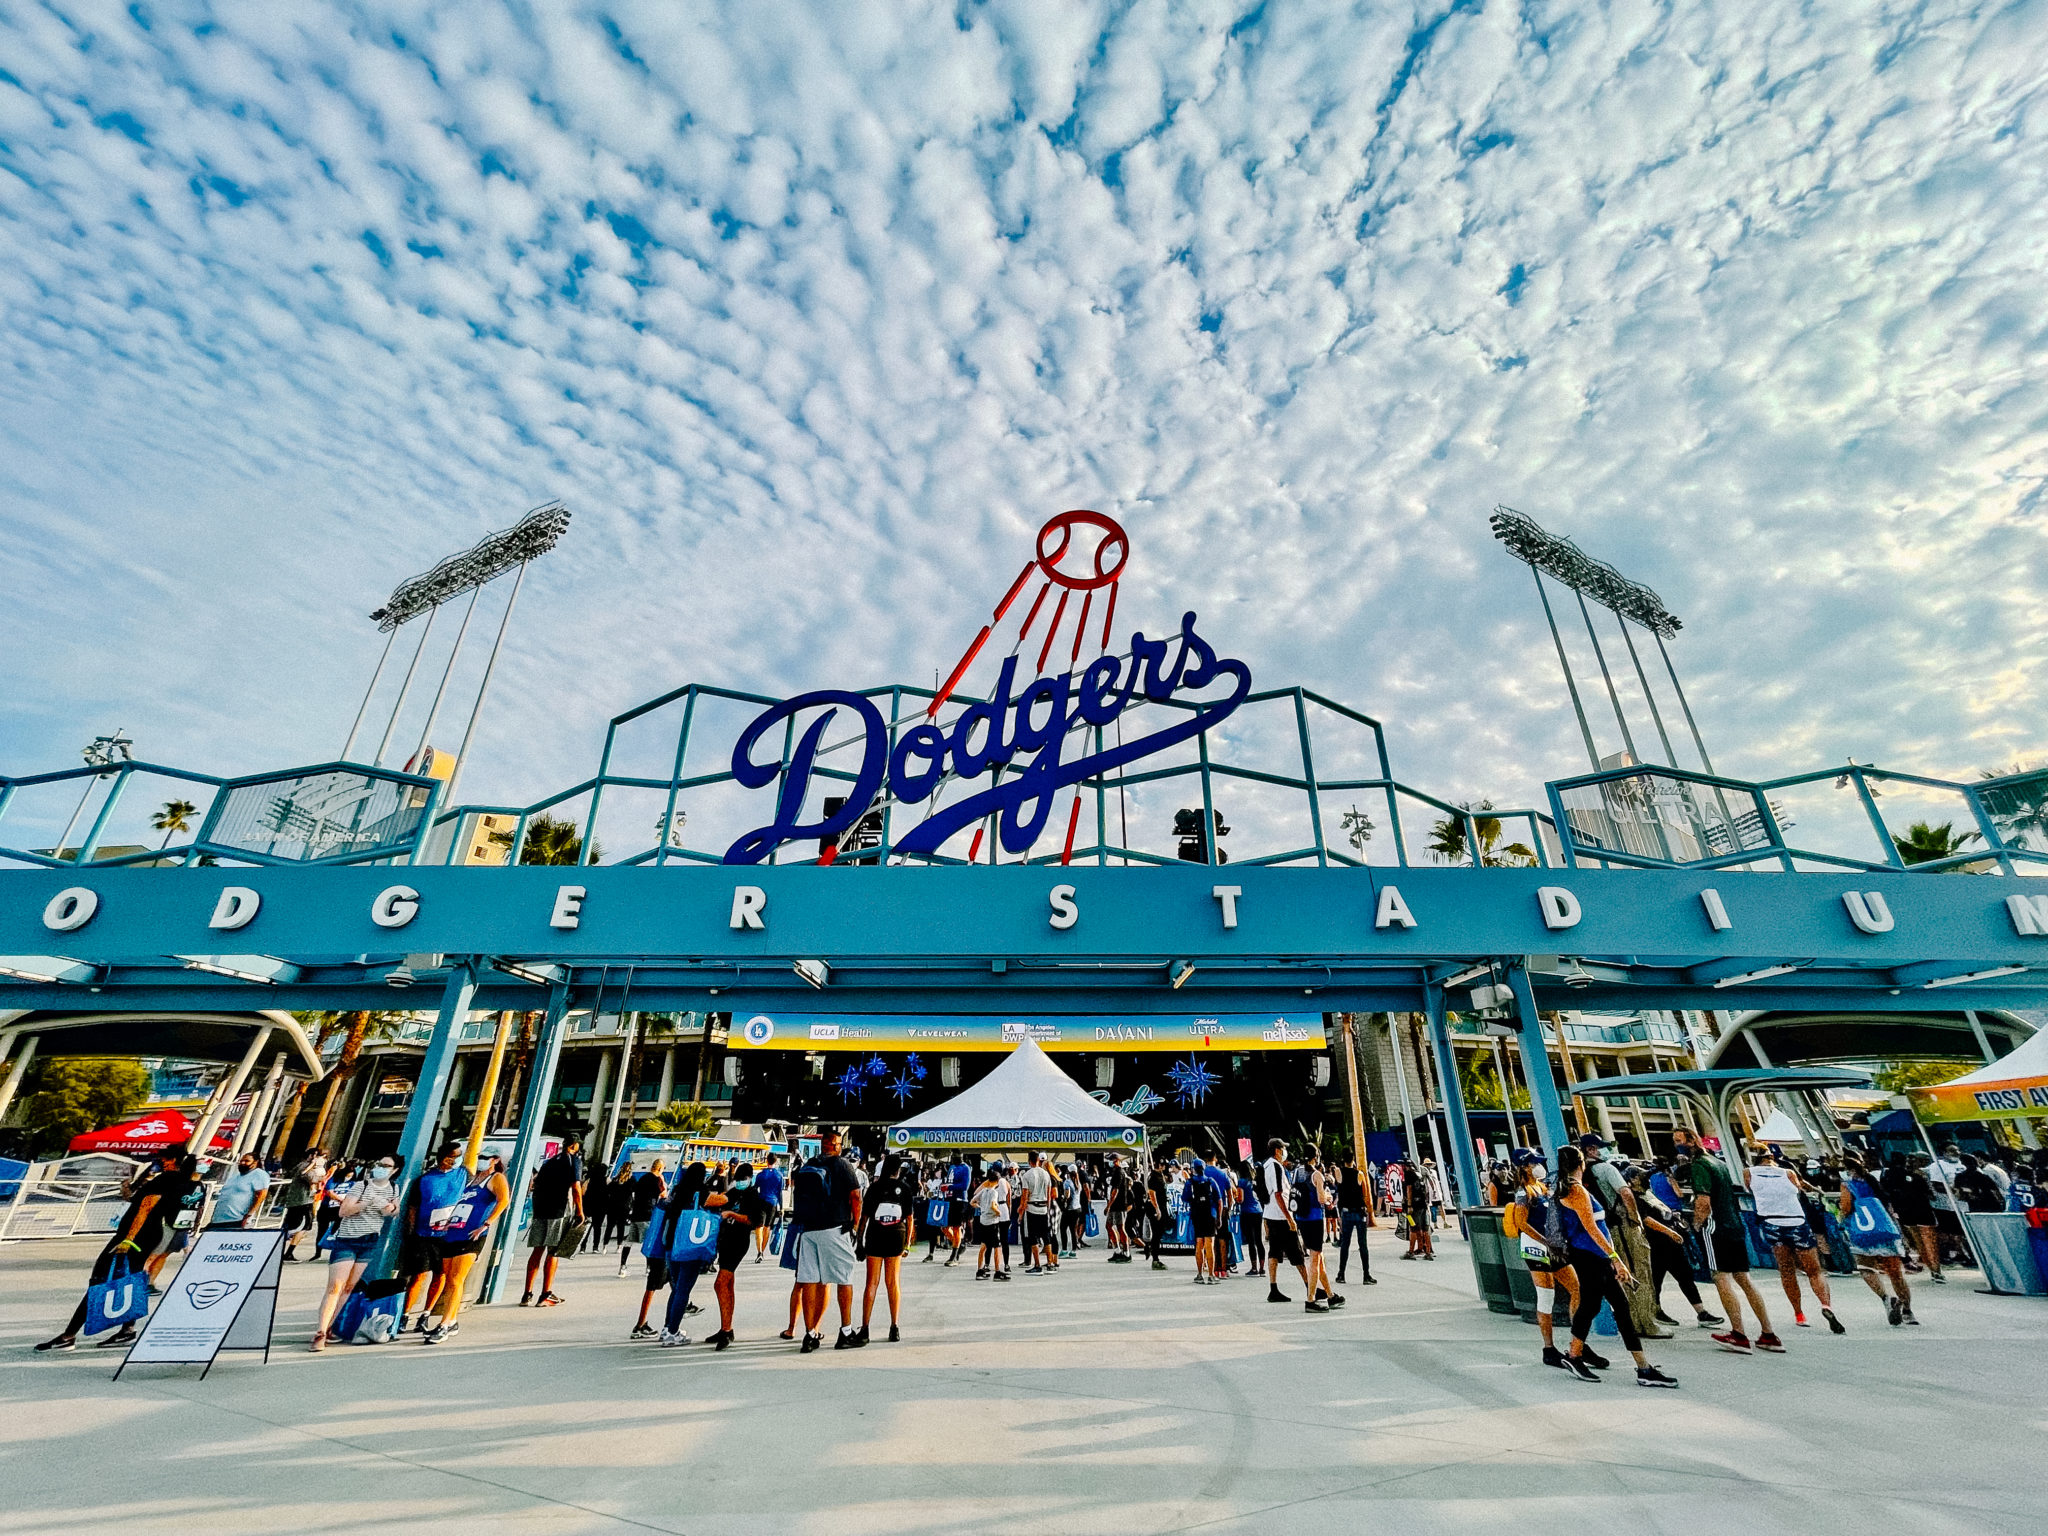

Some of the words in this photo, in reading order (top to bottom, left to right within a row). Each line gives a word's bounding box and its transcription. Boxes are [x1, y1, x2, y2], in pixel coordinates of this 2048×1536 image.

[724, 610, 1251, 865] Dodgers
[1605, 800, 1731, 825] ULTRA
[308, 832, 381, 842] AMERICA
[814, 1028, 835, 1036] UCLA
[841, 1026, 873, 1038] Health
[917, 1029, 969, 1038] LEVELWEAR
[1003, 1024, 1015, 1033] LA
[1095, 1023, 1153, 1043] DASANI
[1189, 1025, 1226, 1035] ULTRA
[1003, 1033, 1025, 1042] DWP
[1974, 1088, 2027, 1111] FIRST
[923, 1130, 942, 1143] LOS
[943, 1130, 989, 1143] ANGELES
[990, 1130, 1040, 1143] DODGERS
[1041, 1130, 1108, 1143] FOUNDATION
[95, 1141, 171, 1150] MARINES
[1390, 1178, 1402, 1196] 34
[933, 1204, 945, 1221] U
[1855, 1205, 1875, 1231] U
[689, 1217, 711, 1244] U
[218, 1243, 253, 1251] MASKS
[1528, 1247, 1544, 1257] 1212
[203, 1254, 254, 1263] REQUIRED
[103, 1283, 133, 1319] U
